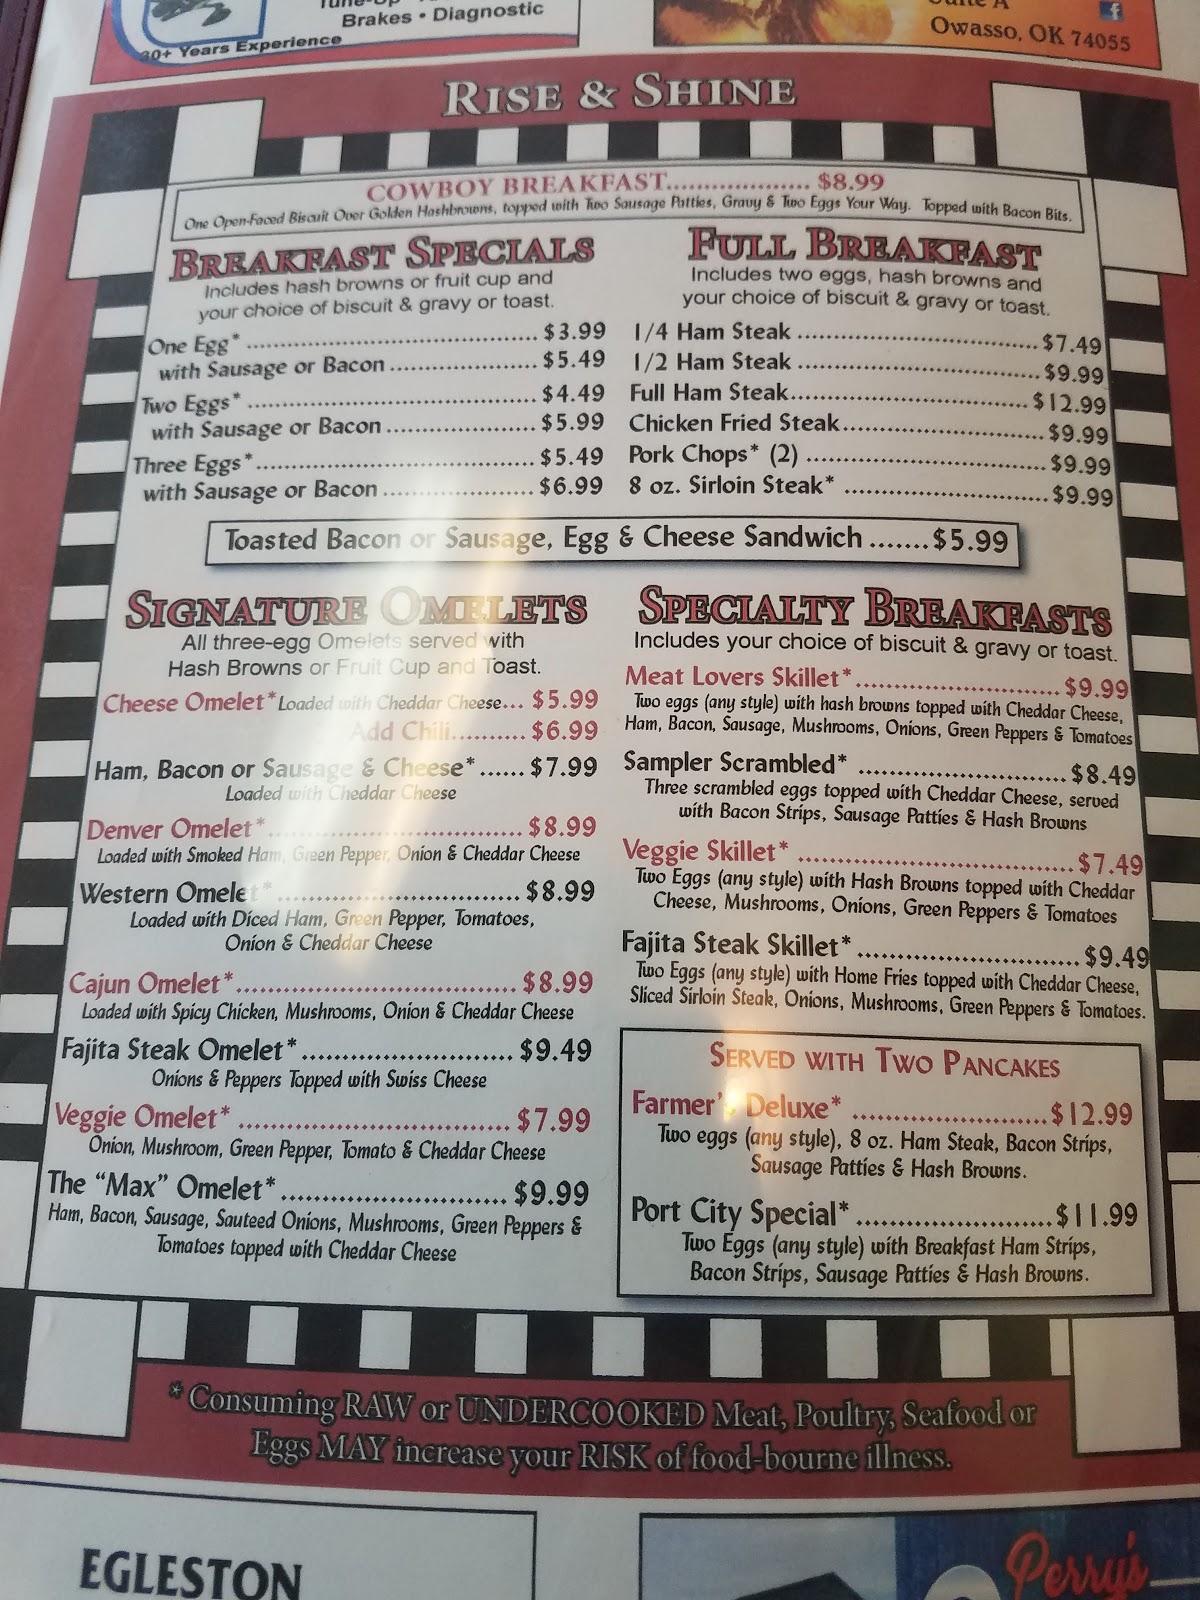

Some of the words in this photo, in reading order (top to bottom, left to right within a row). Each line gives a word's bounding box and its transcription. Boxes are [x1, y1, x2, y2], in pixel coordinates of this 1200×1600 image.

[342, 12, 413, 28] Brakes
[434, 2, 544, 22] Diagnostic
[178, 43, 230, 57] Years
[236, 34, 342, 53] Experience
[930, 16, 1022, 42] Owasso,
[1029, 24, 1065, 45] OK
[1071, 31, 1132, 52] 74055
[442, 78, 565, 119] RISE
[576, 79, 619, 111] &
[632, 71, 798, 110] SHINE
[367, 178, 495, 201] COWBOY
[504, 171, 669, 197] BREAKFAST
[817, 171, 885, 192] $8.99
[184, 217, 209, 230] One
[213, 211, 285, 231] Open-Faced
[288, 210, 329, 225] Biscuit
[334, 208, 364, 222] Over
[368, 206, 413, 220] Golden
[417, 202, 498, 218] Hashbrowns,
[503, 200, 548, 217] topped
[551, 198, 579, 212] with
[585, 197, 609, 210] Two
[614, 196, 666, 212] Sausage
[671, 195, 716, 210] Patties,
[721, 194, 762, 212] Gravy
[766, 194, 776, 208] &
[782, 194, 806, 209] Two
[810, 196, 841, 213] Eggs
[845, 196, 876, 210] Your
[879, 197, 912, 215] Way.
[922, 198, 968, 217] Topped
[971, 202, 1000, 216] with
[1002, 204, 1042, 219] Bacon
[1045, 207, 1073, 223] Bits.
[169, 244, 396, 283] BREAKFAST
[405, 235, 596, 271] SPECIALS
[687, 226, 797, 263] FULL
[805, 226, 1042, 272] BREAKFAST
[691, 266, 772, 282] Includes
[779, 267, 815, 281] two
[821, 267, 871, 286] eggs,
[879, 266, 926, 284] hash
[932, 269, 1001, 289] browns
[1007, 272, 1042, 292] and
[634, 322, 668, 343] 1/4
[677, 323, 725, 341] Ham
[732, 321, 792, 341] Steak
[1042, 333, 1102, 356] $7.49
[159, 362, 201, 382] with
[207, 360, 288, 381] Sausage
[294, 362, 316, 374] or
[323, 355, 385, 374] Bacon
[543, 349, 606, 370] $5.49
[629, 413, 713, 433] Chicken
[720, 413, 772, 432] Fried
[779, 412, 841, 432] Steak
[1049, 423, 1109, 446] $9.99
[225, 527, 318, 551] Toasted
[327, 525, 402, 550] Bacon
[410, 532, 435, 549] or
[443, 525, 555, 555] Sausage,
[563, 525, 609, 555] Egg
[618, 523, 634, 547] &
[643, 523, 735, 548] Cheese
[744, 523, 863, 549] Sandwich
[932, 527, 1009, 555] $5.99
[125, 588, 369, 630] SIGNATURE
[638, 584, 854, 625] SPECIALTY
[863, 586, 1112, 638] BREAKFASTS
[634, 631, 720, 650] Includes
[726, 635, 773, 653] your
[778, 633, 847, 651] choice
[853, 633, 875, 651] of
[879, 634, 947, 654] biscuit
[952, 637, 969, 655] &
[974, 641, 1031, 662] gravy
[1037, 644, 1059, 659] or
[1063, 643, 1118, 663] toast.
[625, 665, 684, 686] Meat
[693, 665, 765, 688] Lovers
[1065, 677, 1129, 700] $9.99
[634, 692, 661, 709] Two
[665, 697, 699, 713] eggs
[704, 693, 736, 714] (any
[740, 693, 779, 715] style)
[784, 695, 815, 711] with
[820, 695, 854, 712] hash
[858, 695, 910, 714] browns
[915, 698, 966, 719] topped
[970, 699, 1001, 717] with
[1005, 701, 1067, 721] Cheddar
[1069, 704, 1124, 725] Cheese,
[130, 909, 188, 929] Loaded
[191, 909, 227, 928] with
[231, 909, 279, 928] Diced
[284, 910, 328, 930] Ham,
[335, 909, 381, 928] Green
[388, 908, 446, 932] Pepper,
[454, 908, 535, 929] Tomatoes,
[82, 1001, 133, 1020] Loaded
[135, 1002, 167, 1021] with
[170, 1001, 212, 1026] Spicy
[216, 1001, 278, 1023] Chicken,
[285, 1001, 376, 1022] Mushrooms,
[383, 1000, 430, 1020] Onion
[435, 1000, 446, 1020] &
[451, 1000, 517, 1021] Cheddar
[520, 1001, 574, 1021] Cheese
[710, 1041, 796, 1070] SERVED
[804, 1051, 864, 1073] WITH
[874, 1047, 934, 1075] TWO
[943, 1049, 1061, 1079] PANCAKES
[47, 1169, 87, 1195] The
[514, 1179, 590, 1207] $9.99
[631, 1194, 682, 1224] Port
[690, 1196, 743, 1232] City
[1055, 1202, 1138, 1229] $11.99
[689, 1260, 746, 1282] Bacon
[751, 1261, 809, 1289] Strips,
[815, 1262, 889, 1290] Sausage
[895, 1263, 951, 1284] Patties
[956, 1263, 969, 1284] &
[974, 1263, 1019, 1284] Hash
[1024, 1263, 1089, 1284] Browns.
[189, 1383, 336, 1425] Consuming
[344, 1391, 413, 1420] RAW
[421, 1401, 450, 1421] or
[458, 1395, 705, 1428] UNDERCOOKED
[713, 1402, 789, 1430] Meat,
[796, 1401, 897, 1436] Poultry,
[902, 1399, 1004, 1427] Seafood
[1009, 1405, 1037, 1424] or
[252, 1429, 311, 1466] Eggs
[318, 1434, 387, 1463] MAY
[396, 1438, 503, 1467] increase
[509, 1447, 573, 1477] your
[580, 1443, 648, 1470] RISK
[656, 1441, 688, 1470] of
[691, 1441, 859, 1471] food-bourne
[866, 1441, 953, 1470] illness.
[80, 1547, 302, 1600] EGLESTON
[1006, 1530, 1148, 1600] Perry's
